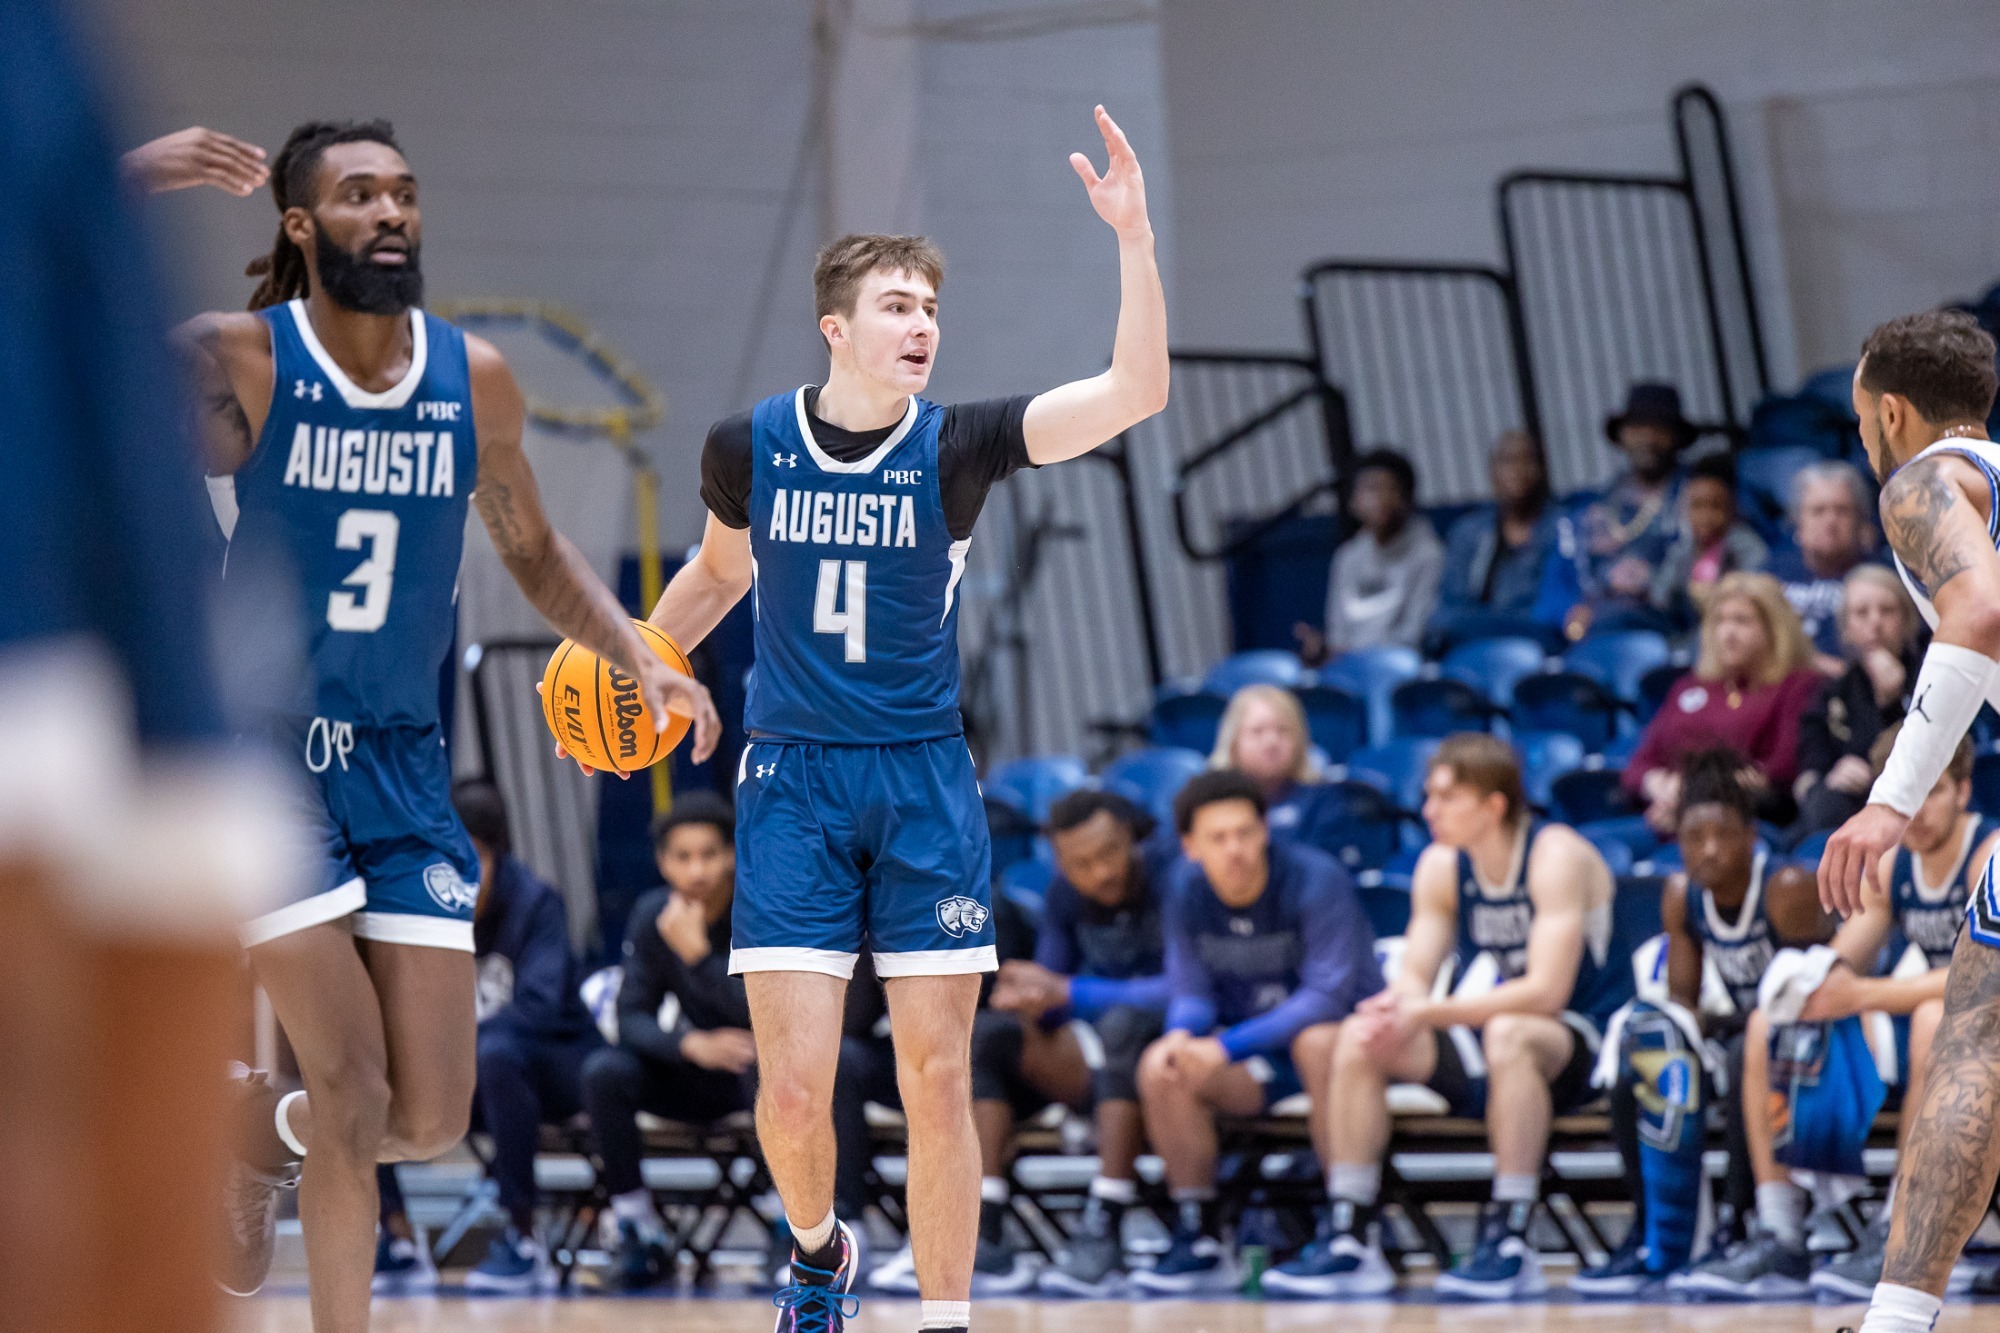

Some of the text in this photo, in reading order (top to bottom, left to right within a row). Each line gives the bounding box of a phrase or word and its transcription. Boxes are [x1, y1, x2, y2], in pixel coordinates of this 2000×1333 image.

[417, 401, 461, 421] PBC
[283, 422, 455, 497] AUGUSTA
[883, 469, 922, 485] PBC
[769, 488, 916, 548] AUGUSTA
[326, 508, 400, 632] 3
[813, 559, 867, 663] 4
[564, 684, 588, 744] EVO
